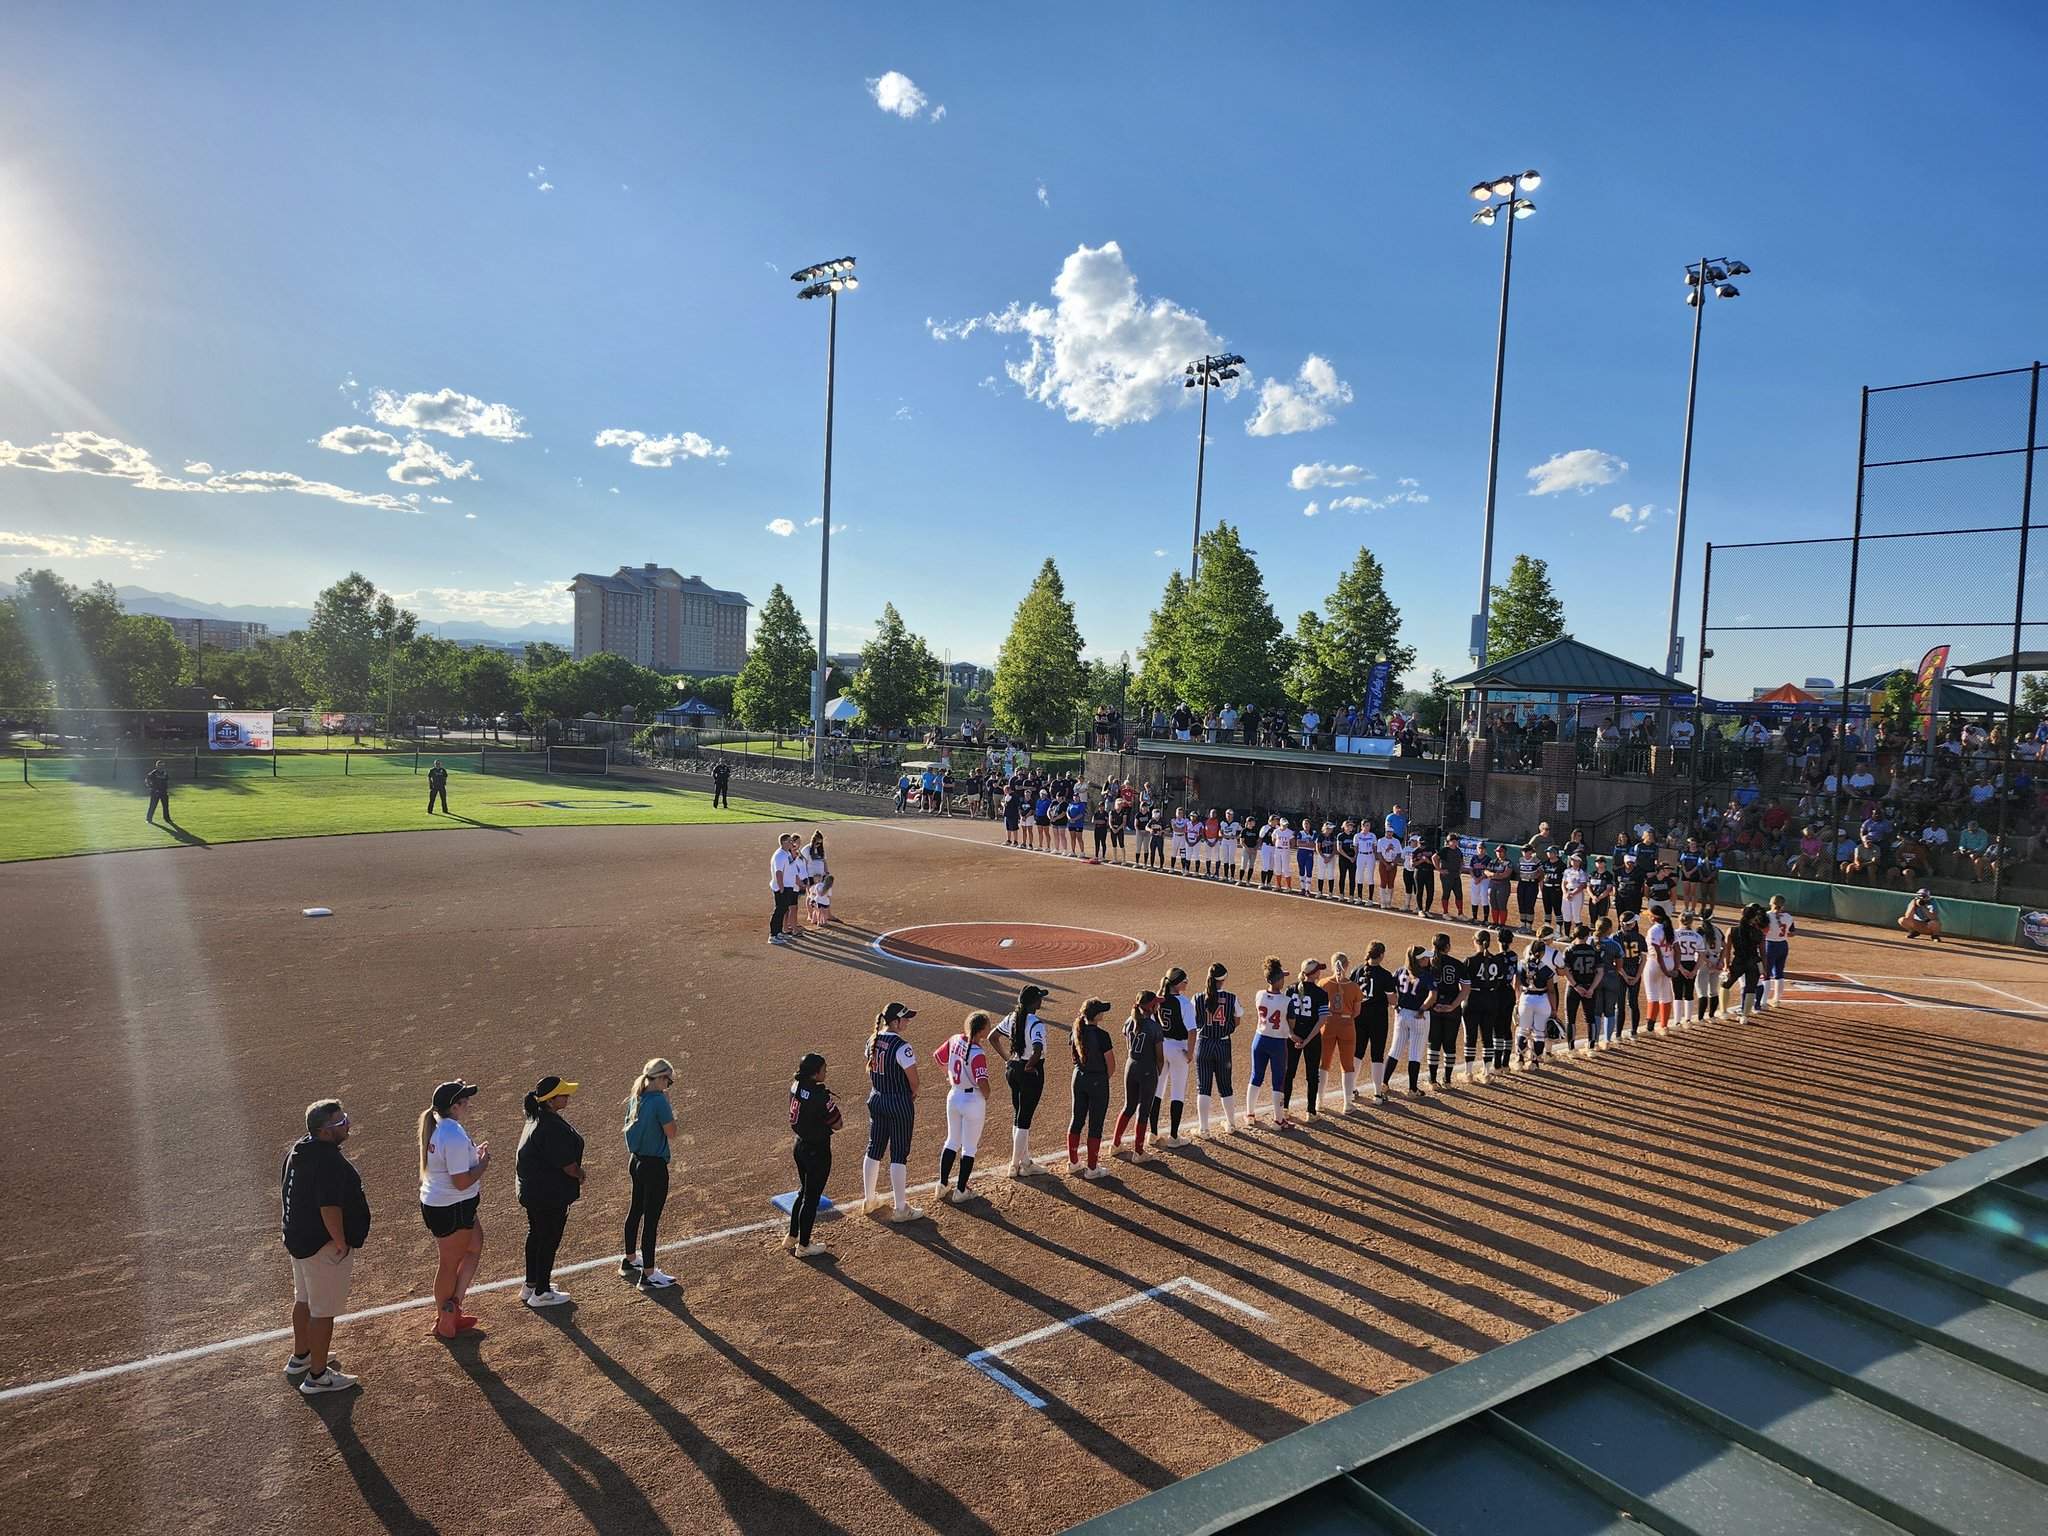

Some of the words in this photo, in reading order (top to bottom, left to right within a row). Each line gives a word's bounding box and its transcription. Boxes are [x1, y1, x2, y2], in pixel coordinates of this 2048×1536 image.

[1622, 941, 1639, 958] 12
[1680, 941, 1697, 956] 55
[1476, 963, 1498, 981] 49
[1573, 956, 1596, 974] 42
[1332, 993, 1343, 1012] 8
[1258, 1006, 1281, 1030] 24
[953, 1059, 962, 1085] 9
[285, 1168, 295, 1223] SAINTS
